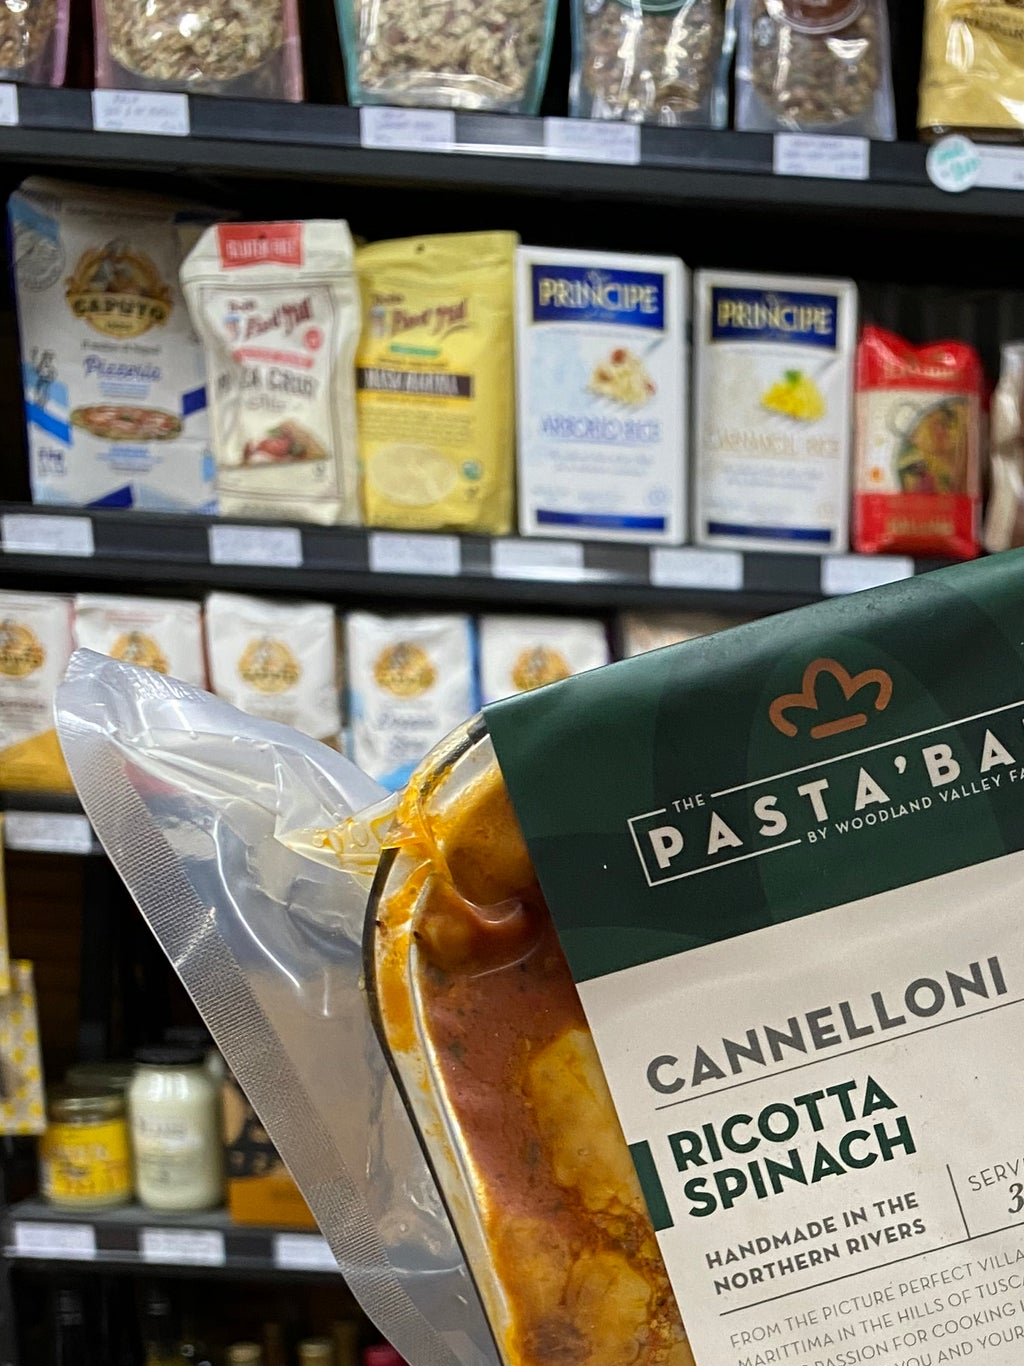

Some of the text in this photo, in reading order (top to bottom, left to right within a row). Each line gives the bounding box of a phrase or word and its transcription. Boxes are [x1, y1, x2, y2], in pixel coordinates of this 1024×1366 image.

[538, 278, 659, 315] PRINCIPE
[717, 299, 833, 335] PRINCIPE
[671, 792, 706, 813] THE
[806, 826, 827, 843] BY
[834, 796, 932, 833] WOODLAND
[938, 774, 1000, 802] VALLEY
[645, 955, 1007, 1094] CANNELLONI
[666, 1075, 898, 1172] RICOTTA
[683, 1115, 917, 1217] SPINACH
[1007, 1182, 1024, 1214] 3
[704, 1191, 919, 1269] HANDMADE IN THE
[712, 1217, 926, 1295] NORTHERN RIVERS
[729, 1322, 781, 1349] FROM
[783, 1309, 818, 1331] THE
[821, 1286, 896, 1320] PICTURE
[897, 1261, 972, 1297] PERFECT
[836, 1324, 855, 1341] IN
[858, 1312, 894, 1334] THE
[896, 1297, 944, 1323] HILLS
[947, 1288, 971, 1307] OF
[891, 1328, 927, 1350] FOR
[931, 1301, 1016, 1338] COOKING
[937, 1340, 973, 1363] AND
[976, 1325, 1024, 1349] YOUR
